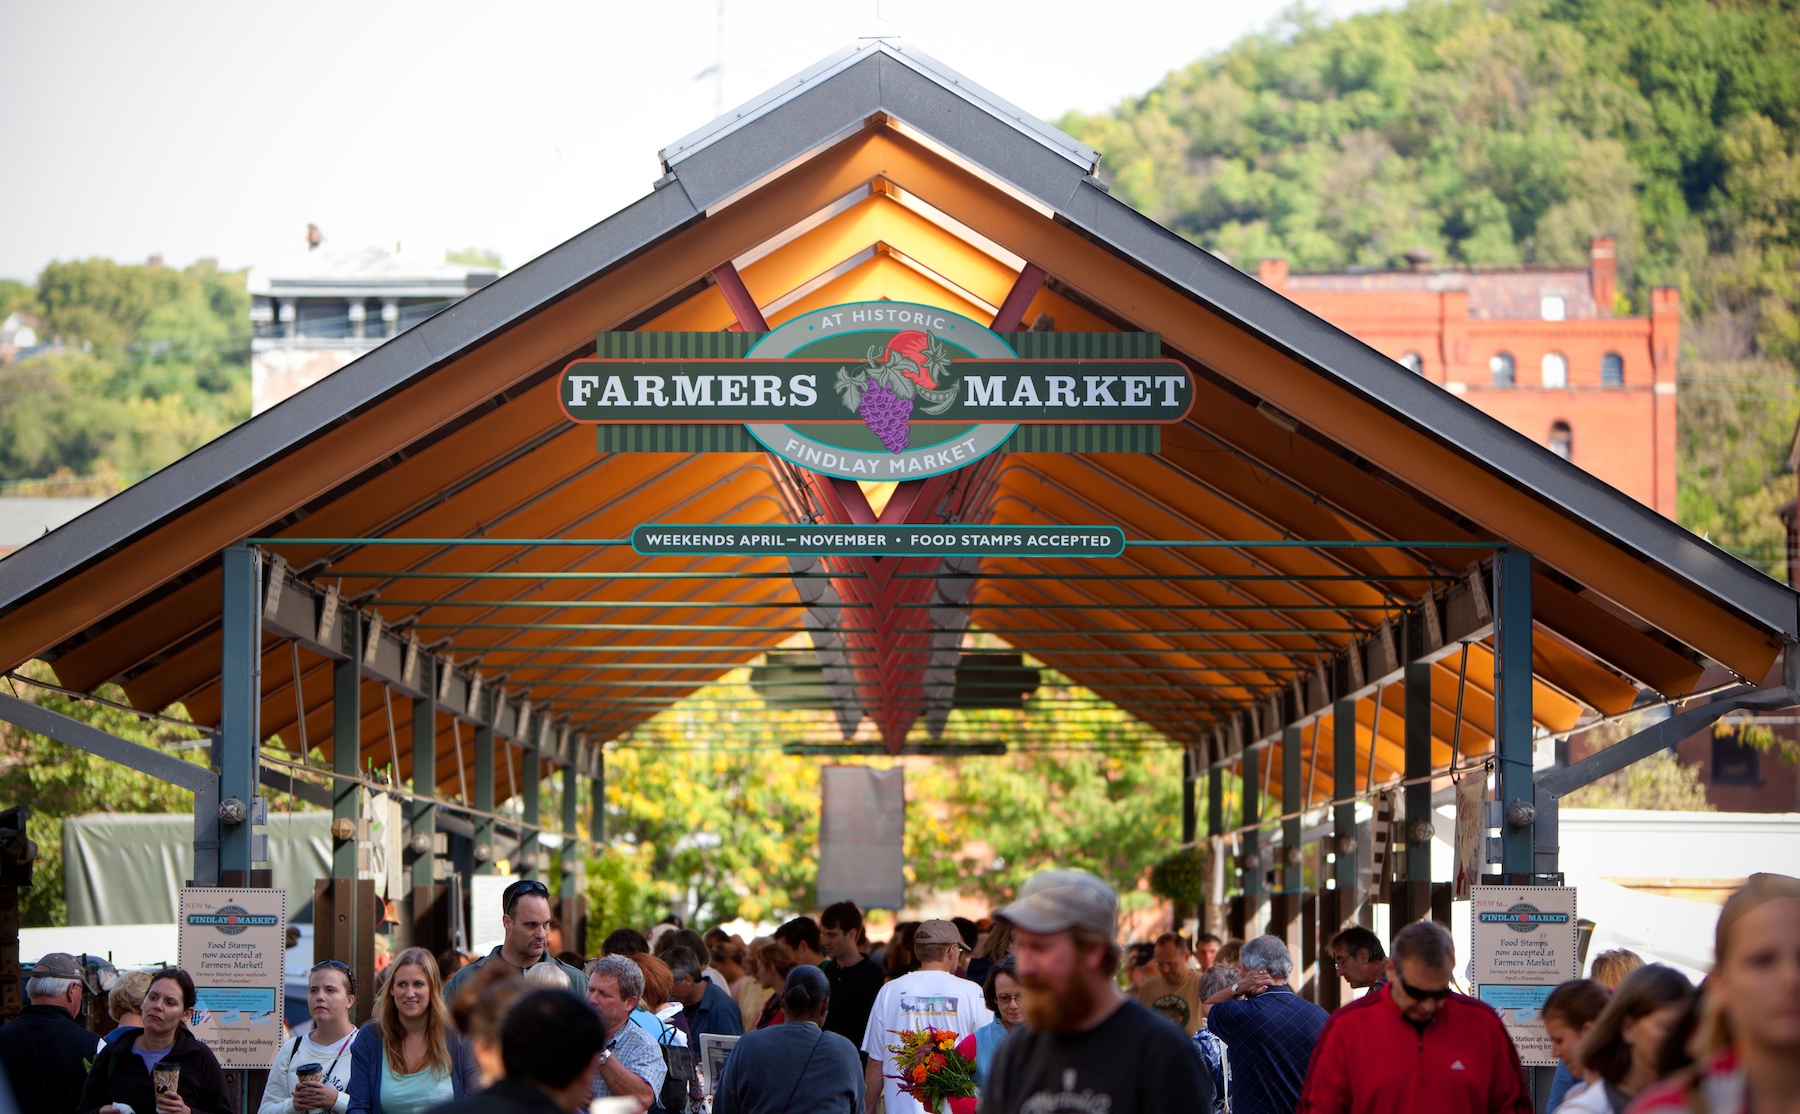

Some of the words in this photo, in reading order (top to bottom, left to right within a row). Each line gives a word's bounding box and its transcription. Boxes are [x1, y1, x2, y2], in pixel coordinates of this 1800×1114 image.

[822, 313, 843, 329] AT
[852, 309, 946, 331] HISTORIC
[569, 375, 818, 408] FARMERS
[964, 375, 1185, 408] MARKET
[785, 438, 880, 474] FINDLAY
[889, 438, 980, 474] MARKET
[646, 534, 735, 546] WEEKENDS
[910, 534, 956, 546] FOOD
[961, 534, 1022, 546] STAMPS
[1027, 534, 1111, 547] ACCEPTED
[228, 942, 256, 950] Stamps
[1521, 939, 1548, 948] Stamps
[220, 952, 253, 960] accepted
[1513, 949, 1545, 957] accepted
